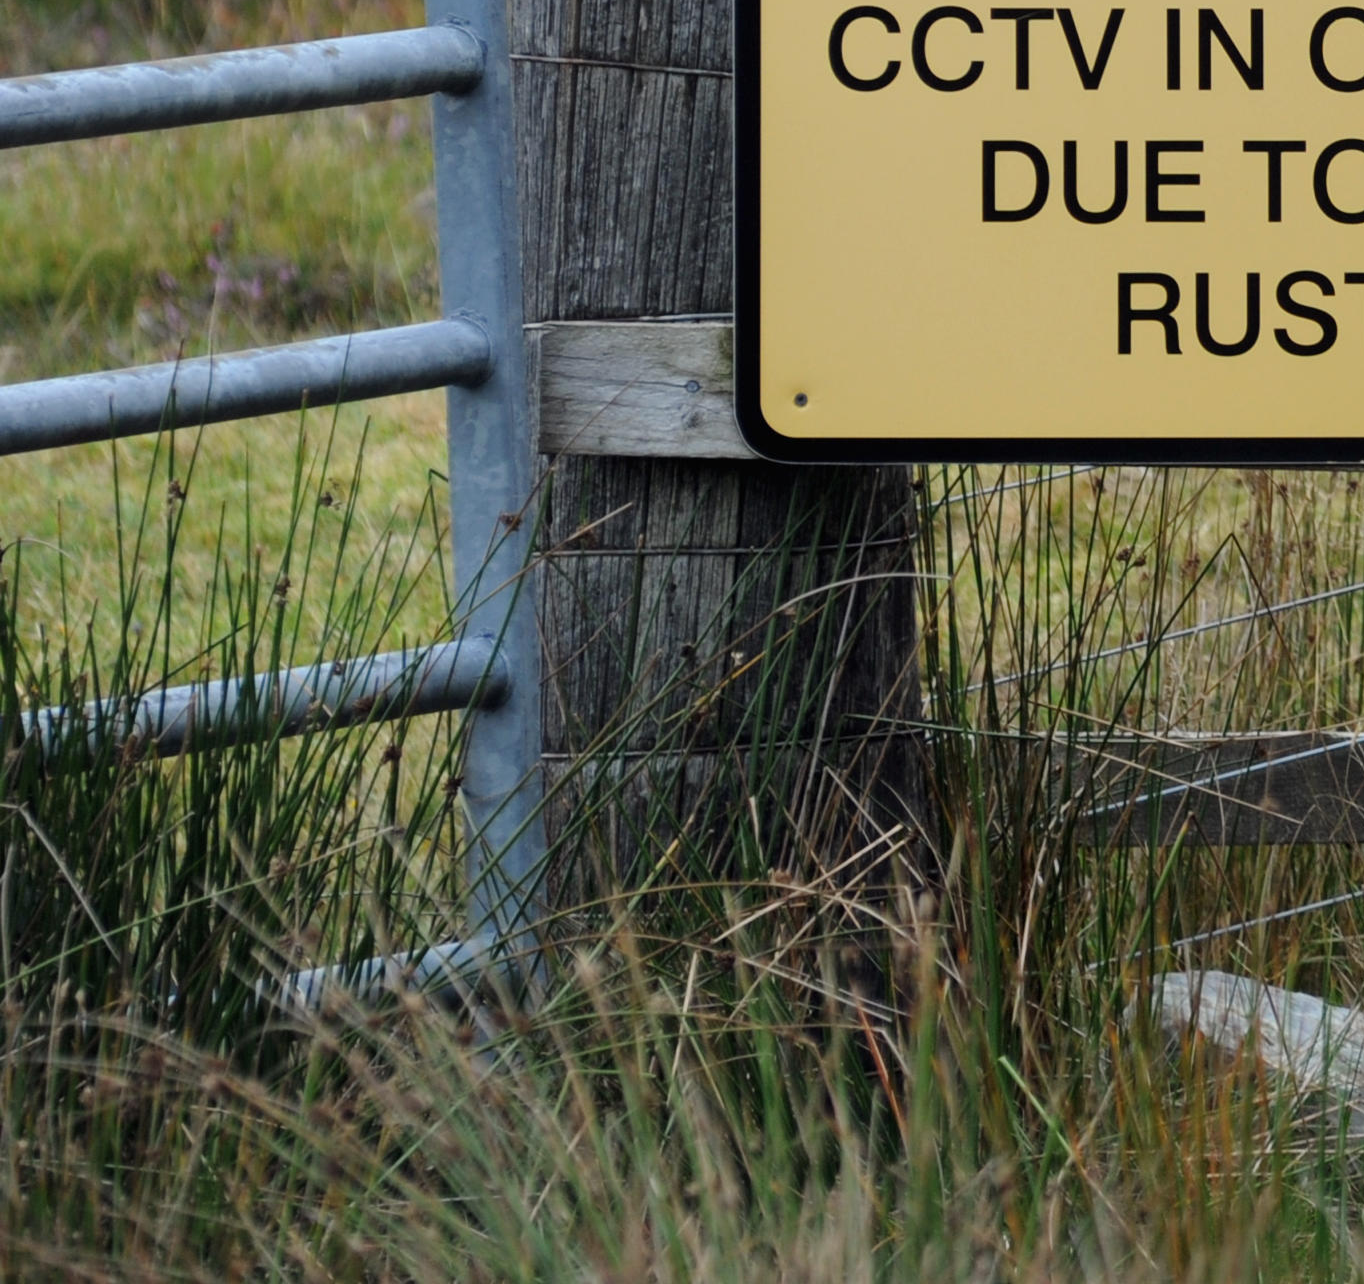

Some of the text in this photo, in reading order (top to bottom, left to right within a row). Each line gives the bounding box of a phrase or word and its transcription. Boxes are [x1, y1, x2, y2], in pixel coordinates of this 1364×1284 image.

[829, 6, 1124, 92] CCTV
[1167, 9, 1263, 90] IN
[983, 141, 1205, 224] DUE
